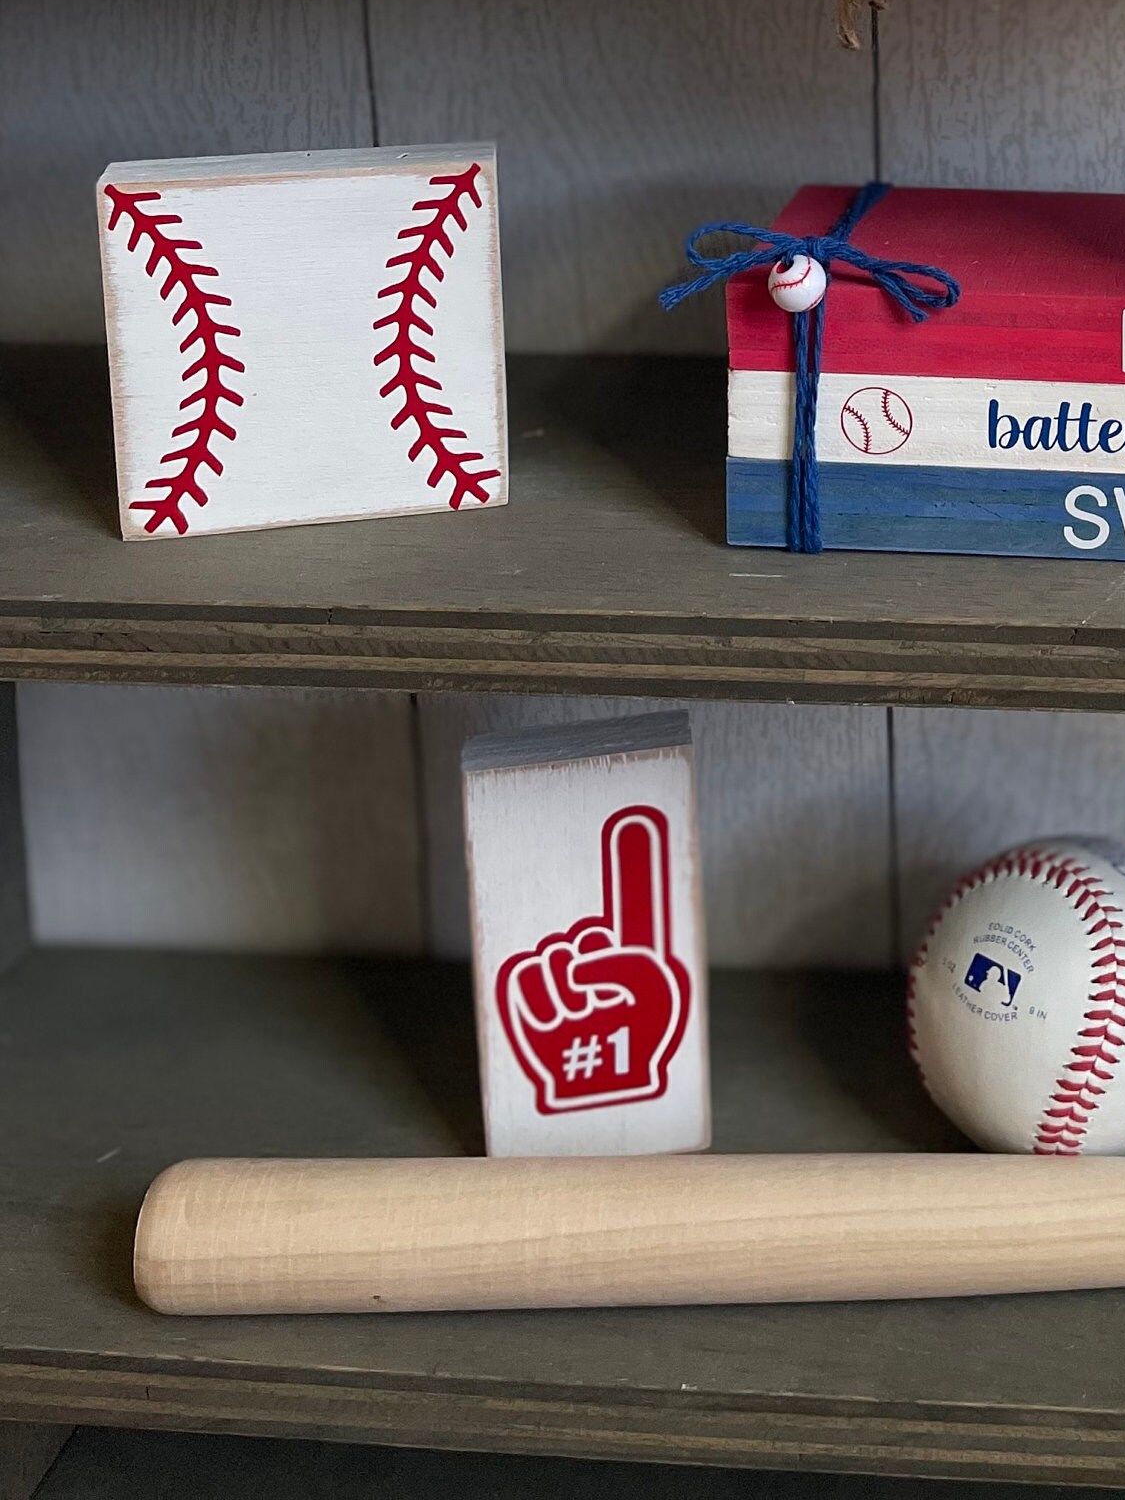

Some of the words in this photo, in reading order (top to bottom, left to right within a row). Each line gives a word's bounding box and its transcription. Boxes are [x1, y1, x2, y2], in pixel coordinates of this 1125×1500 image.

[973, 934, 1008, 946] RUBBER
[1007, 941, 1035, 974] CENTER
[1014, 930, 1037, 952] CORK
[984, 1011, 1018, 1023] COVER
[561, 1025, 630, 1082] #1
